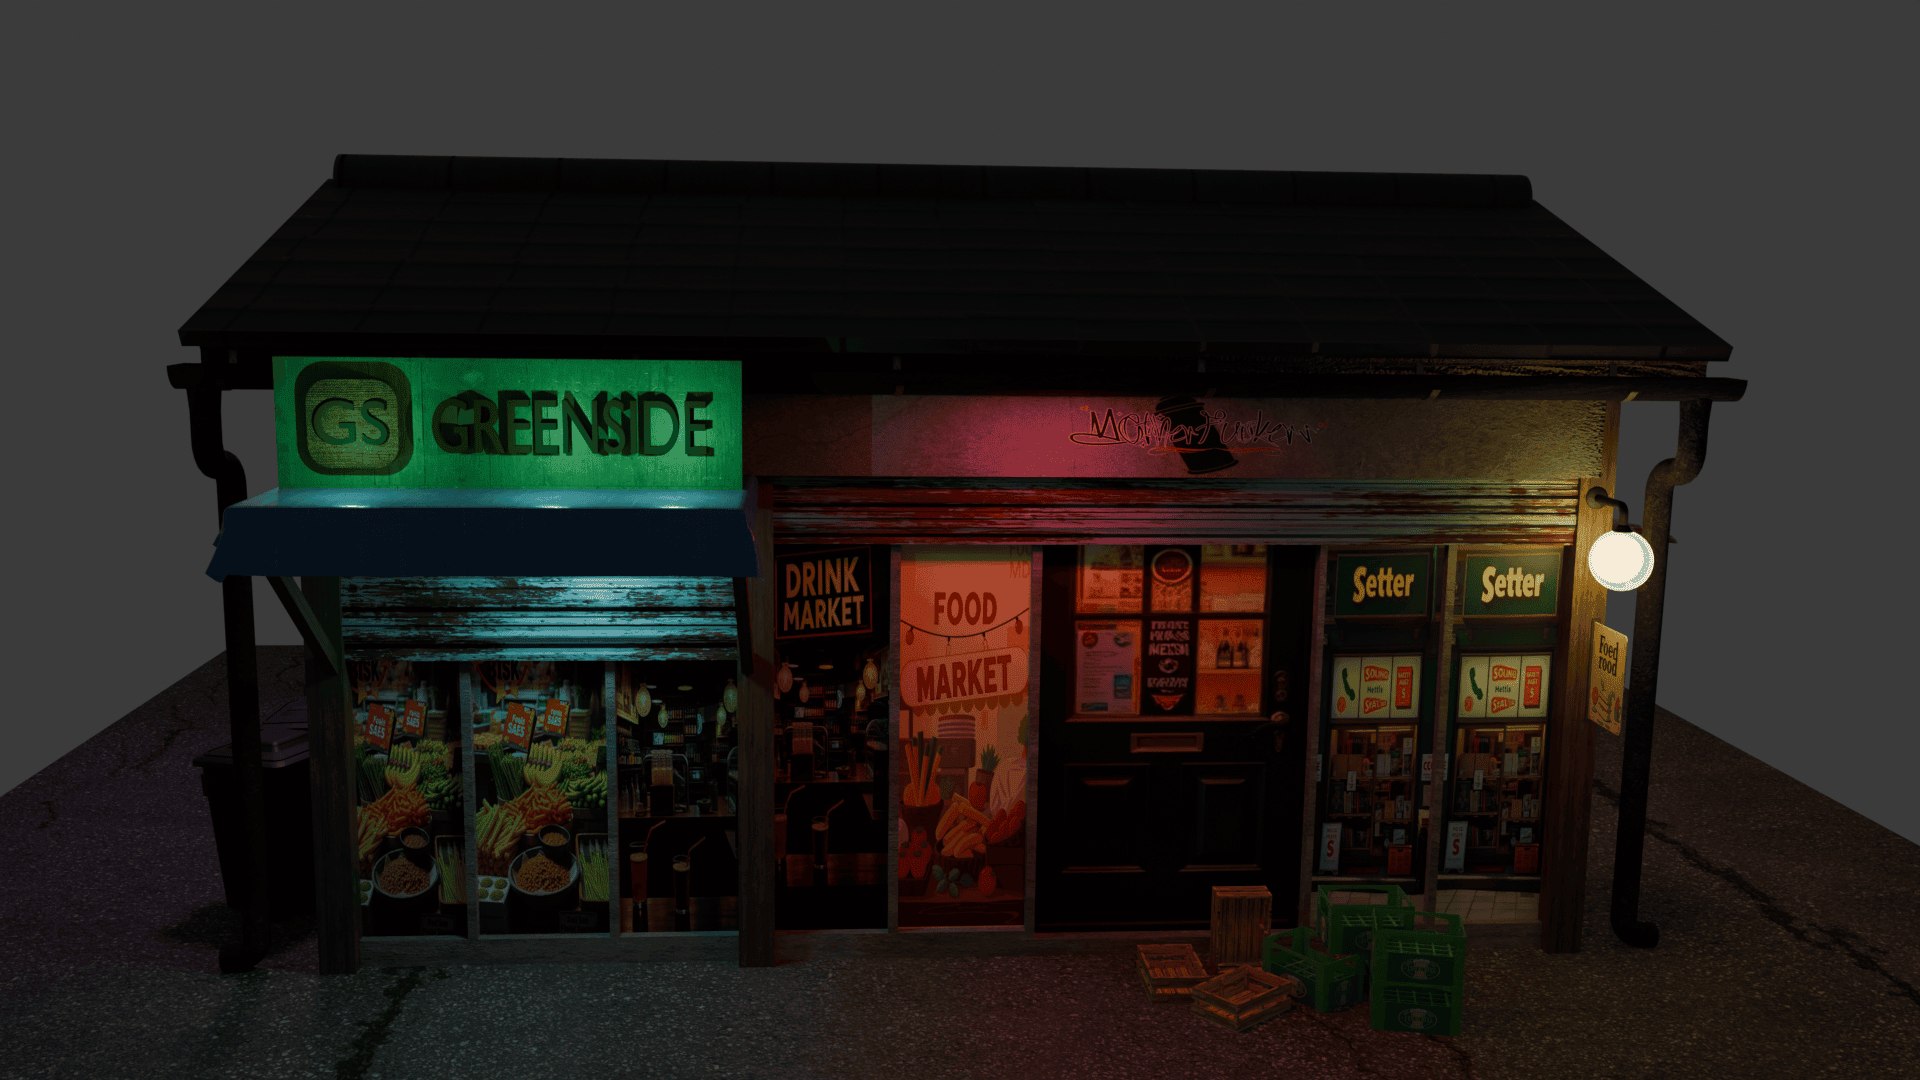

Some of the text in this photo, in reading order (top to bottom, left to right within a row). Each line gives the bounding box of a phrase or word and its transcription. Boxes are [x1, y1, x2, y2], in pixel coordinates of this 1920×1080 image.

[311, 397, 391, 446] GS
[431, 389, 715, 457] GREENSIDE
[785, 556, 861, 598] DRINK
[1352, 565, 1415, 604] Setter
[1481, 565, 1545, 604] Setter
[783, 594, 865, 632] MARKET
[933, 591, 998, 626] FOOD
[915, 654, 1012, 703] MARKET
